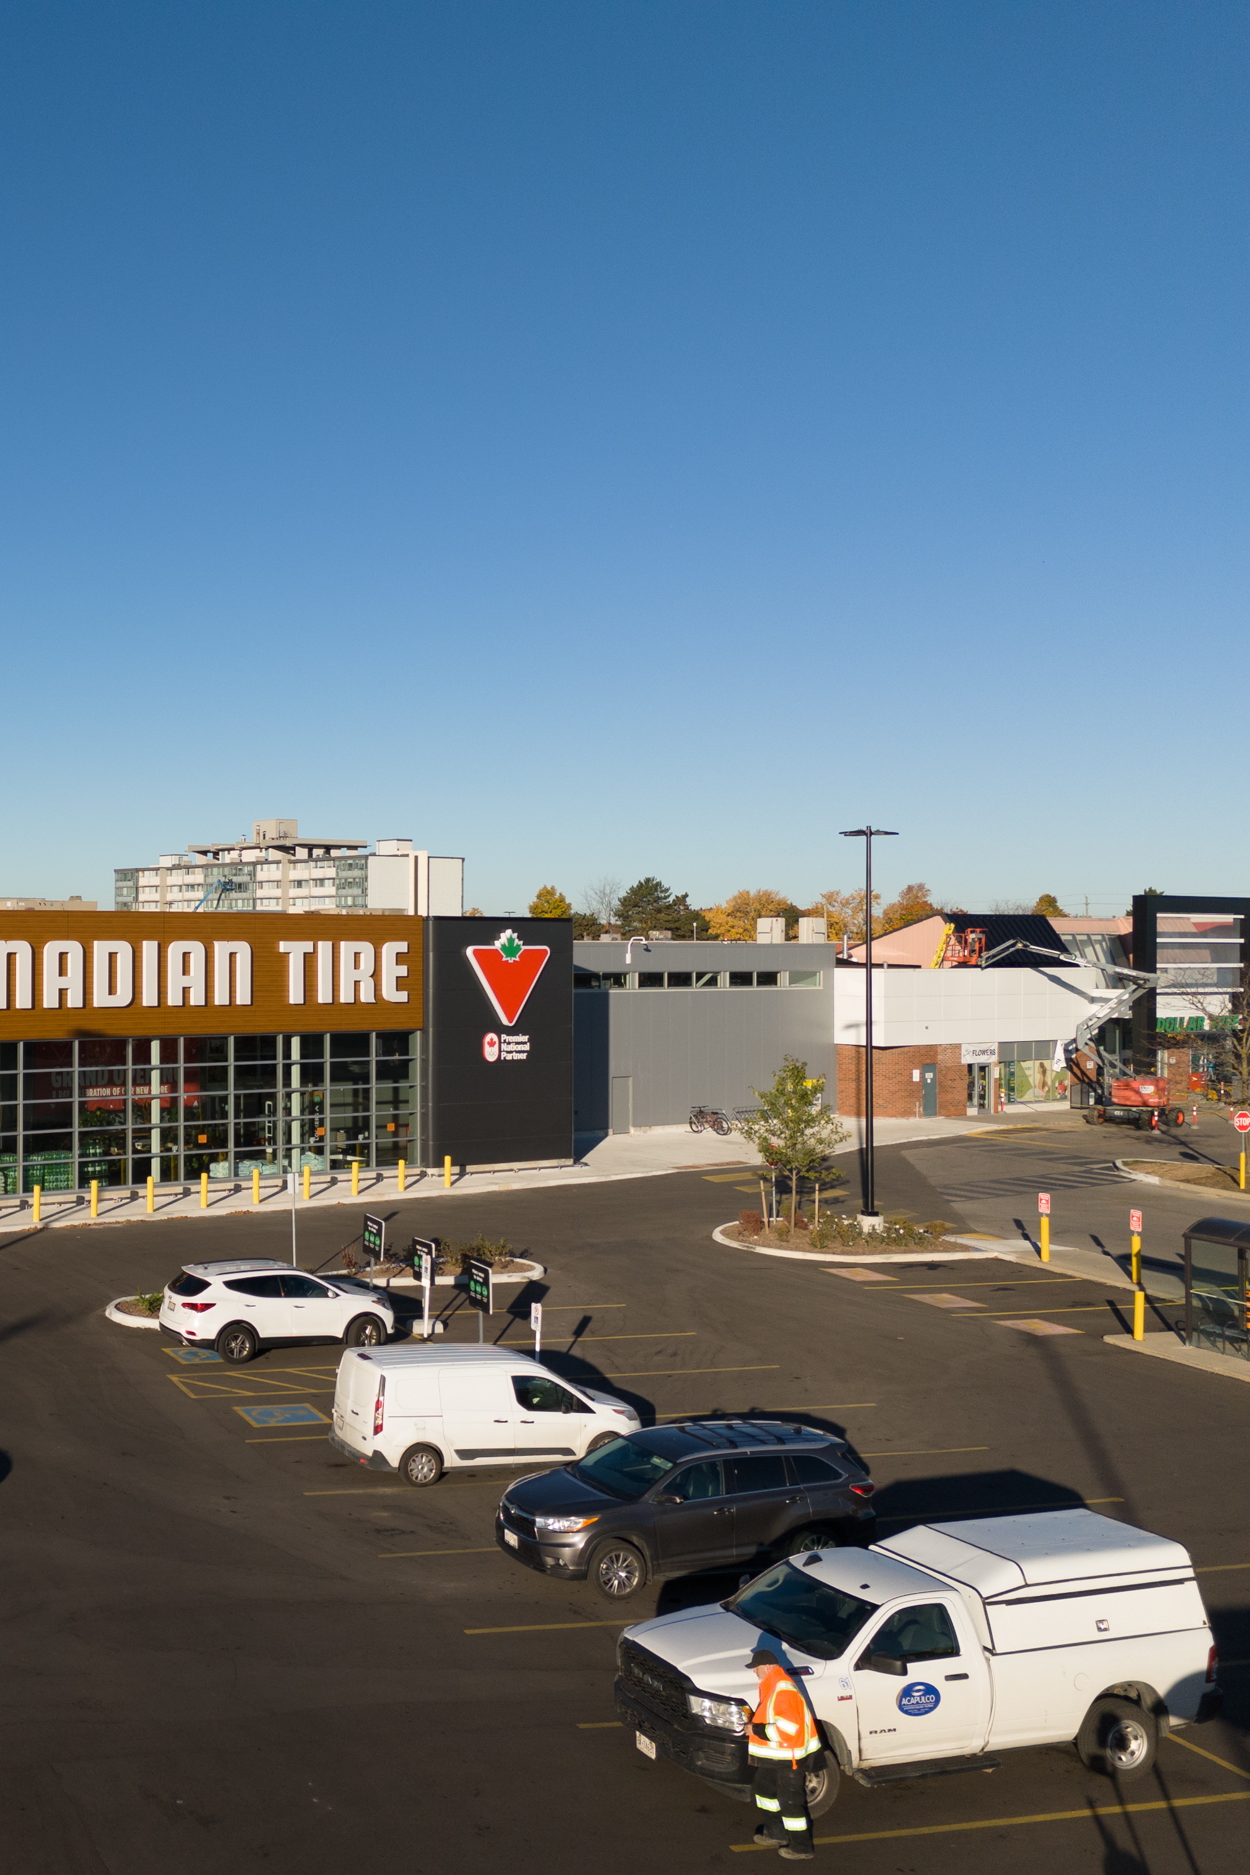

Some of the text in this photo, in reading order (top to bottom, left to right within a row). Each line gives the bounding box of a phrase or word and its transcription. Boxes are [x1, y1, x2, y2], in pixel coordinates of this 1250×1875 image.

[278, 940, 409, 1005] TIRE
[1156, 1016, 1205, 1033] DOLLAR
[500, 1033, 529, 1043] Premier
[500, 1042, 530, 1052] National
[500, 1051, 528, 1061] Partner
[972, 1048, 996, 1057] FLOWERS
[73, 1087, 111, 1098] LEBRATION
[1235, 1117, 1250, 1126] STOP
[901, 1694, 936, 1706] ACAPULCO
